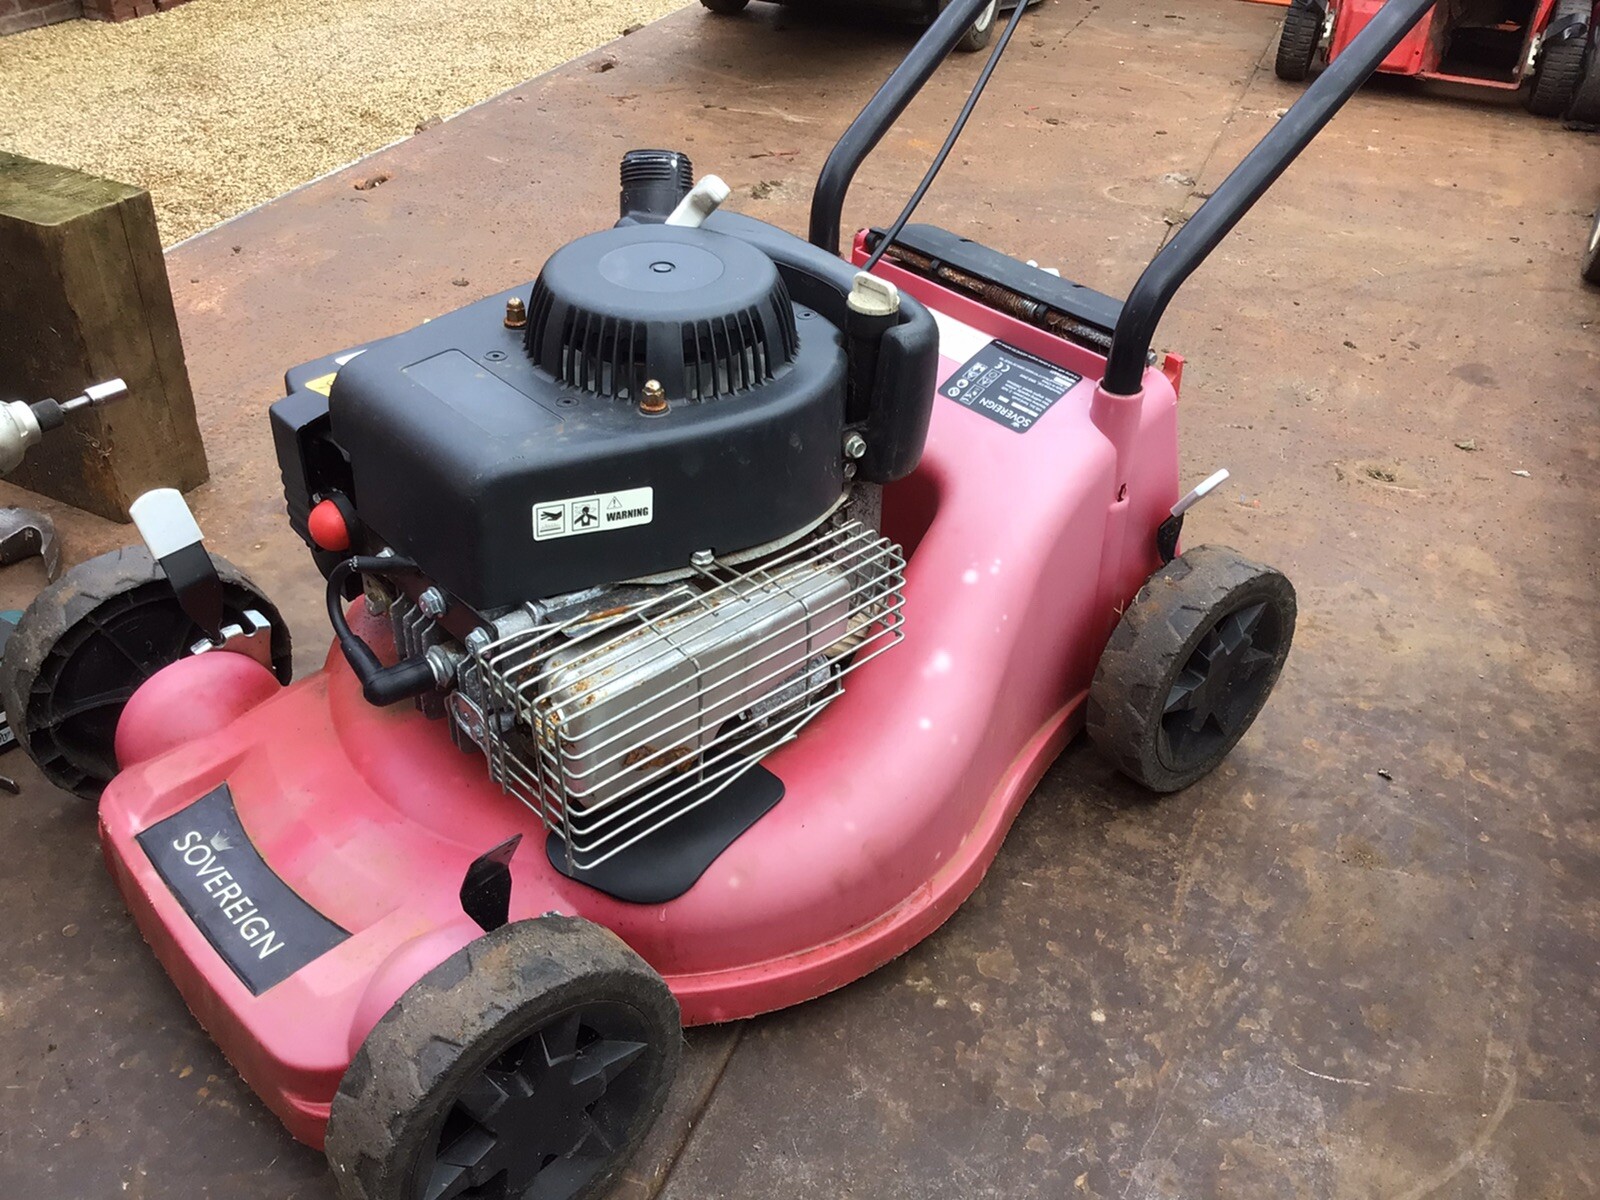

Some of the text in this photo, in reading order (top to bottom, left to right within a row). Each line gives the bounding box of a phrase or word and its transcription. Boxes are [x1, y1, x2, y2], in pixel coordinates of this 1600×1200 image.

[979, 397, 1032, 428] SOVEREIGN
[606, 507, 649, 522] WARNING
[173, 830, 285, 960] SOVEREIGN
